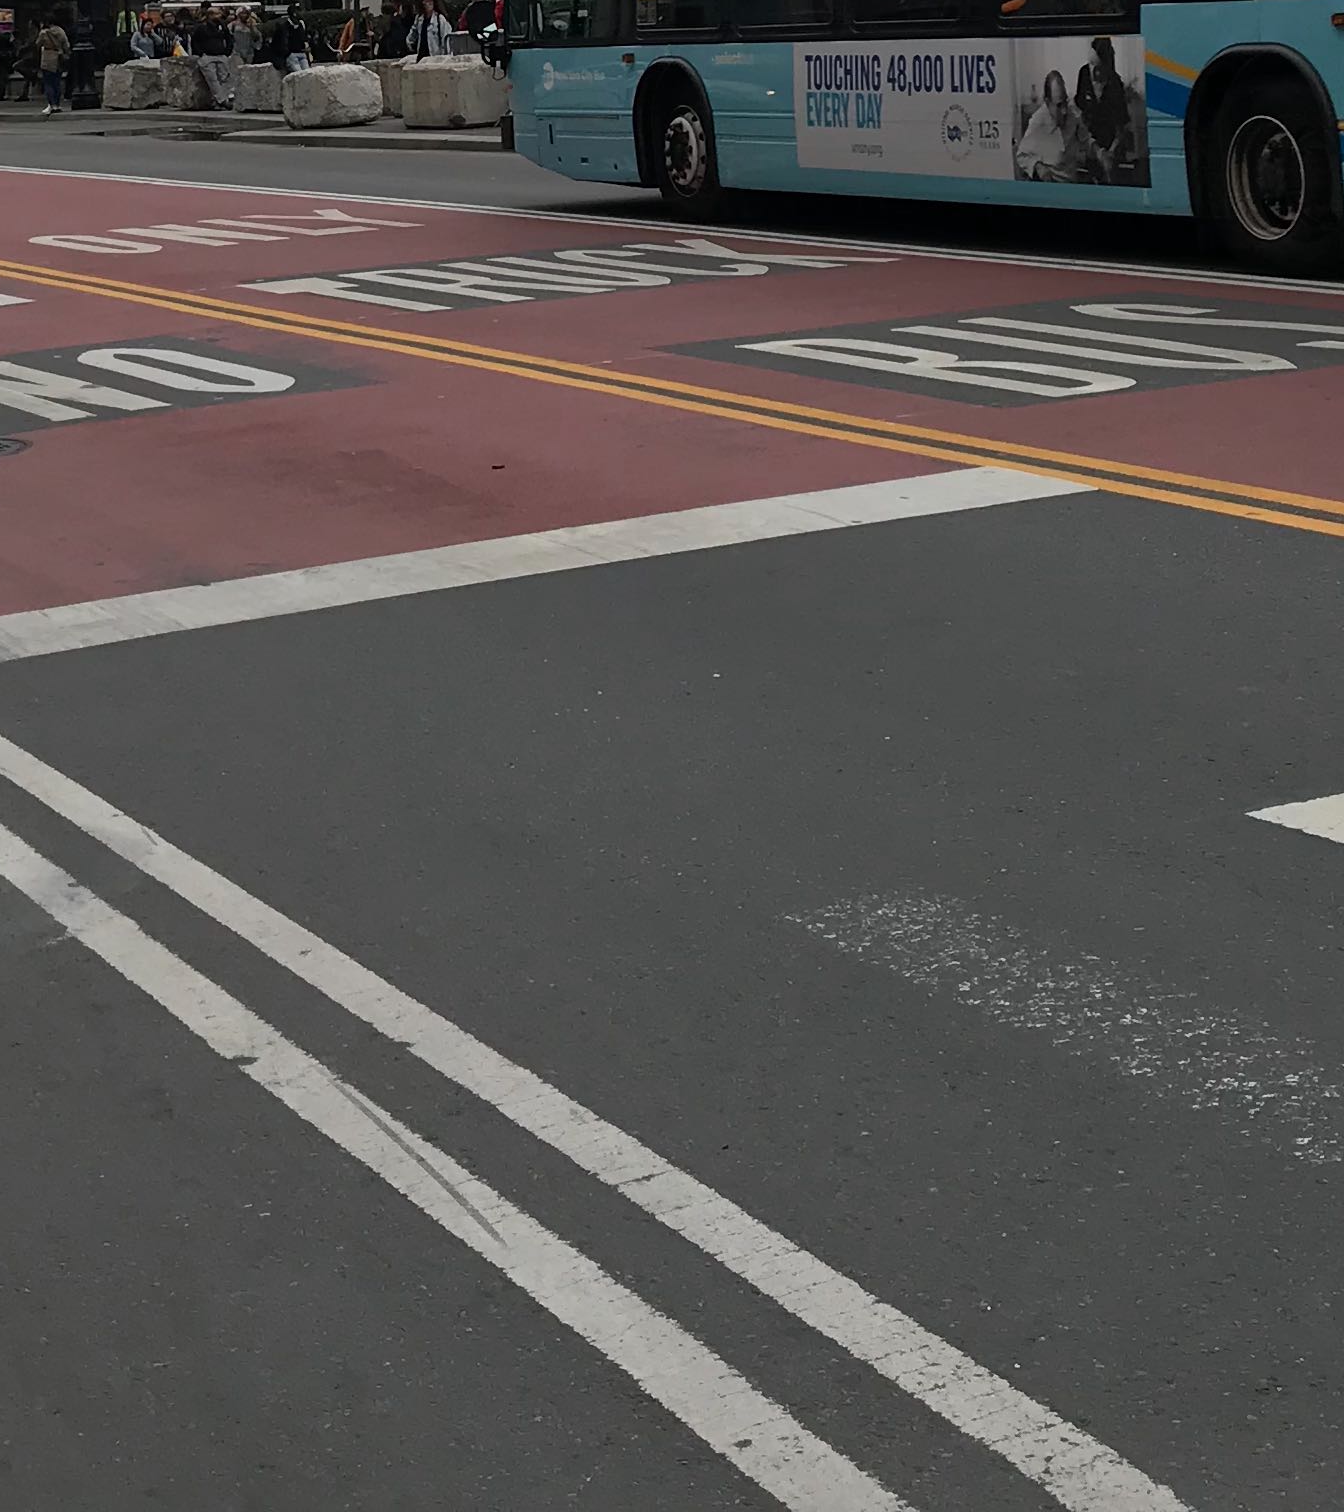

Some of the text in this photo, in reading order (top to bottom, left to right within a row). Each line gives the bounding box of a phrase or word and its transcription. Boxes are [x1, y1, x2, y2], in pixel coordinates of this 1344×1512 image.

[805, 54, 996, 96] TOUCHING 48,000 LIVES
[807, 92, 883, 129] EVERY DAY
[978, 120, 1000, 139] 125
[29, 209, 425, 254] ONLY
[236, 239, 901, 312] TRUCK
